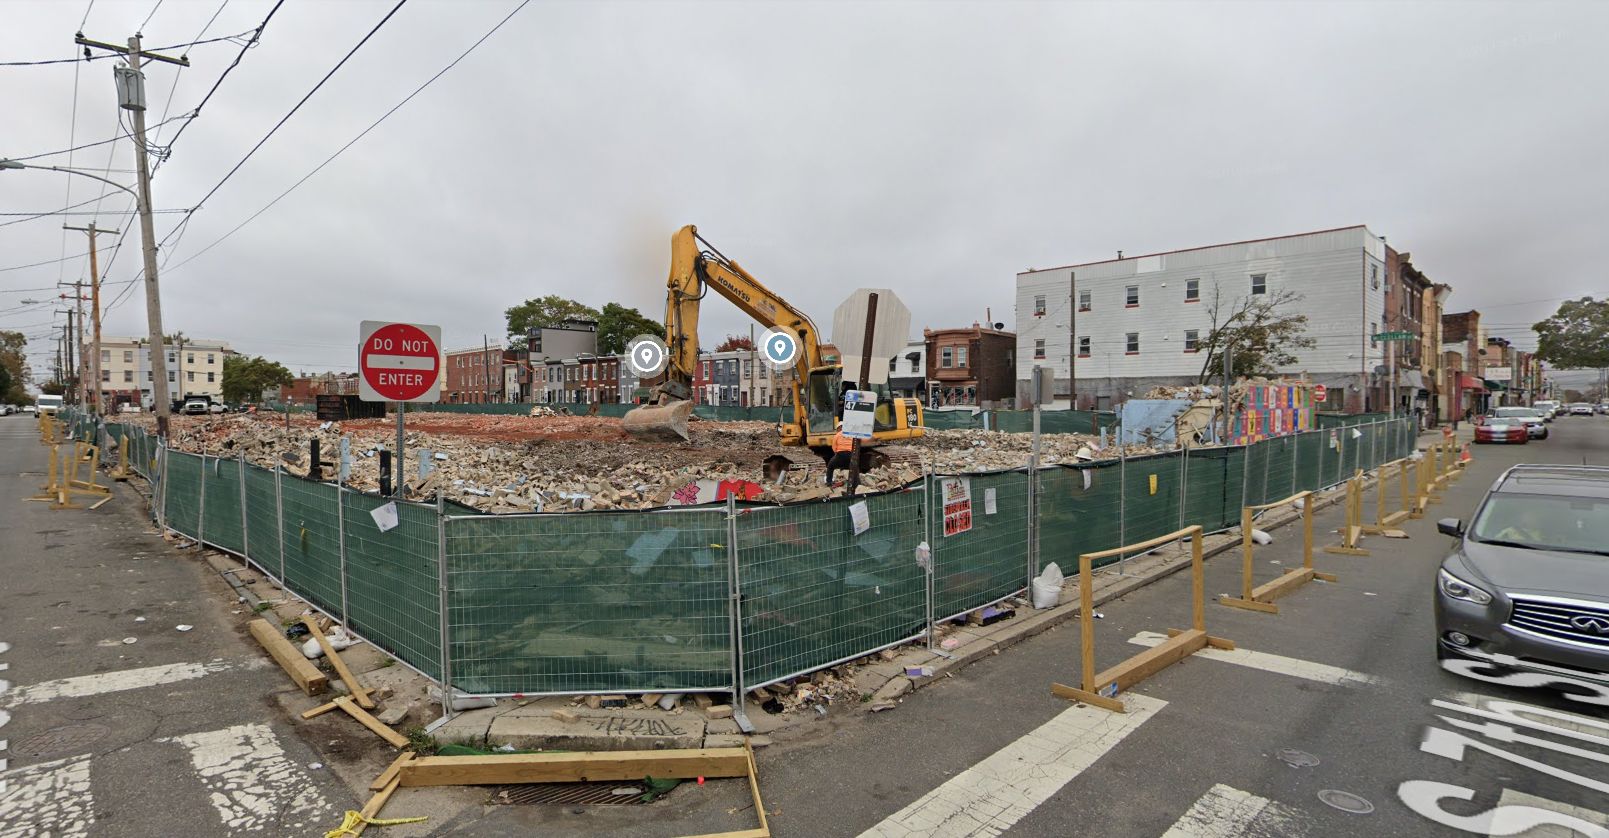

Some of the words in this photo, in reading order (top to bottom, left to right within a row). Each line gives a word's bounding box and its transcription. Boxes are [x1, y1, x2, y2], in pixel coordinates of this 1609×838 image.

[718, 276, 750, 302] KOMATSU
[374, 338, 393, 351] DO
[402, 340, 429, 353] NOT
[379, 373, 423, 386] ENTER
[845, 401, 856, 411] 47
